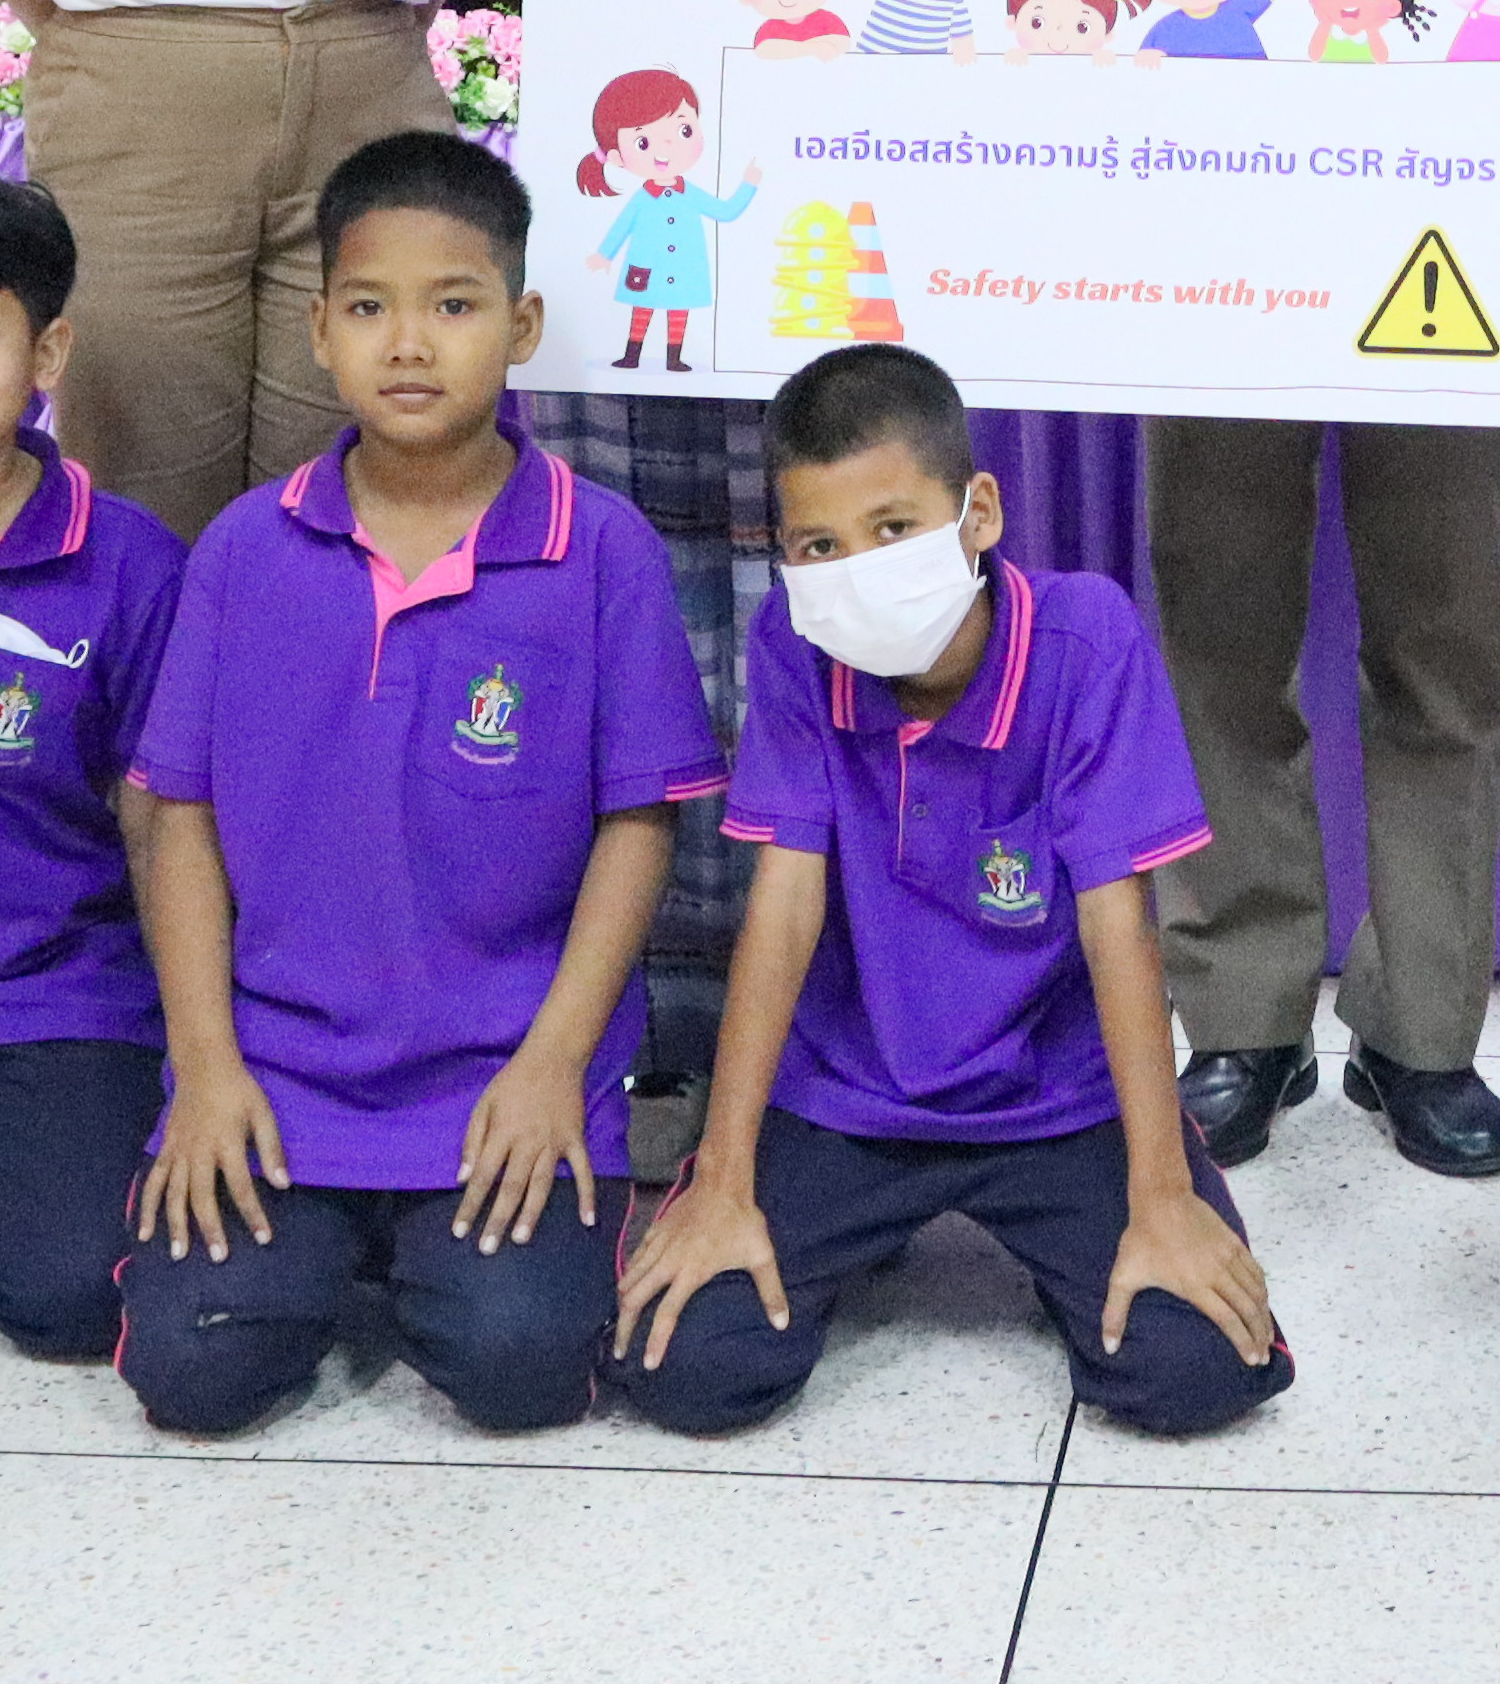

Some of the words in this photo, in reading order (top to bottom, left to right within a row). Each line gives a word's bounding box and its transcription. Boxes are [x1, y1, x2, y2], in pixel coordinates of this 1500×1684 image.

[794, 129, 1120, 179] เอสจีเอสสร้างความรู้
[1130, 136, 1297, 180] สู่สังคมกับ
[1309, 147, 1384, 178] CSR
[1395, 147, 1496, 187] สัญจร
[926, 268, 1046, 305] Safety
[1052, 278, 1164, 304] starts
[1173, 278, 1256, 307] with
[1261, 289, 1332, 314] you
